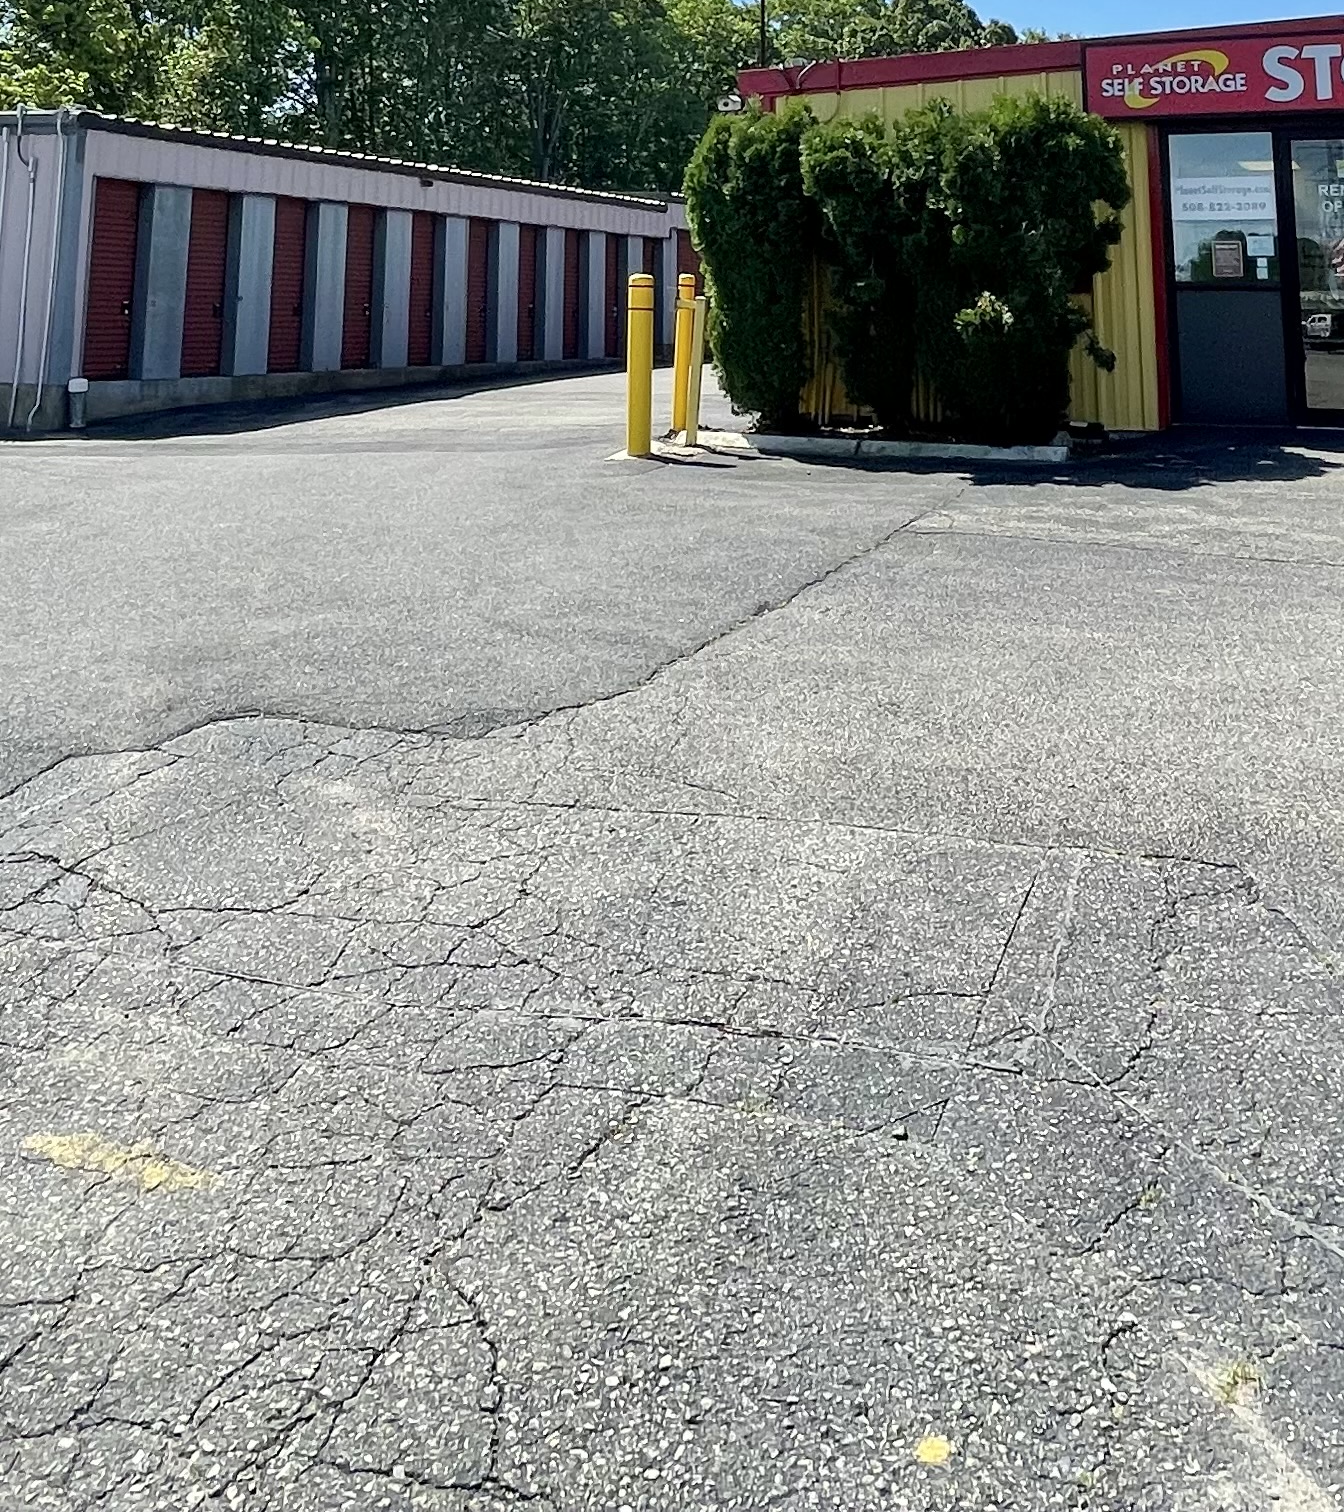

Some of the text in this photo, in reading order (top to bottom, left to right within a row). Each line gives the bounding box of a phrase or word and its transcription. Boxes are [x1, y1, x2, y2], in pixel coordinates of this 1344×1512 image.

[1112, 61, 1202, 75] PLANET
[1101, 73, 1248, 97] SELF STORAGE
